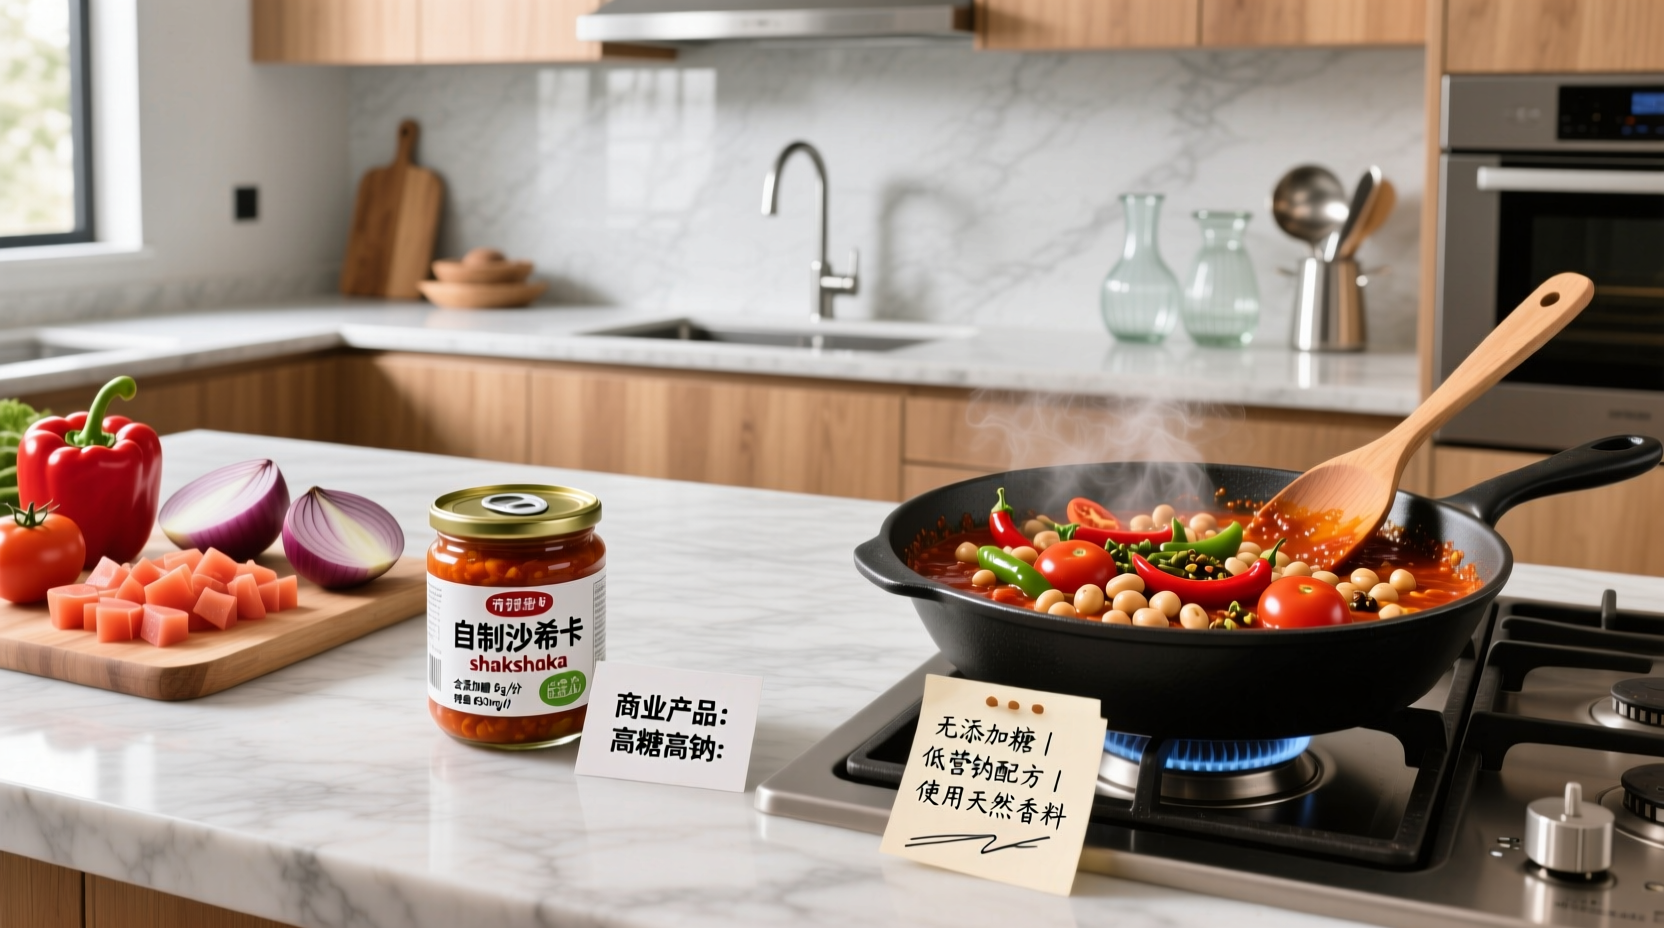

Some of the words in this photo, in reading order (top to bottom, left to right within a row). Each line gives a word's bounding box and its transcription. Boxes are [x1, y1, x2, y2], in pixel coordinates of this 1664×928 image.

[454, 616, 584, 653] 自制沙希卡
[915, 779, 1067, 830] 使用天然香料
